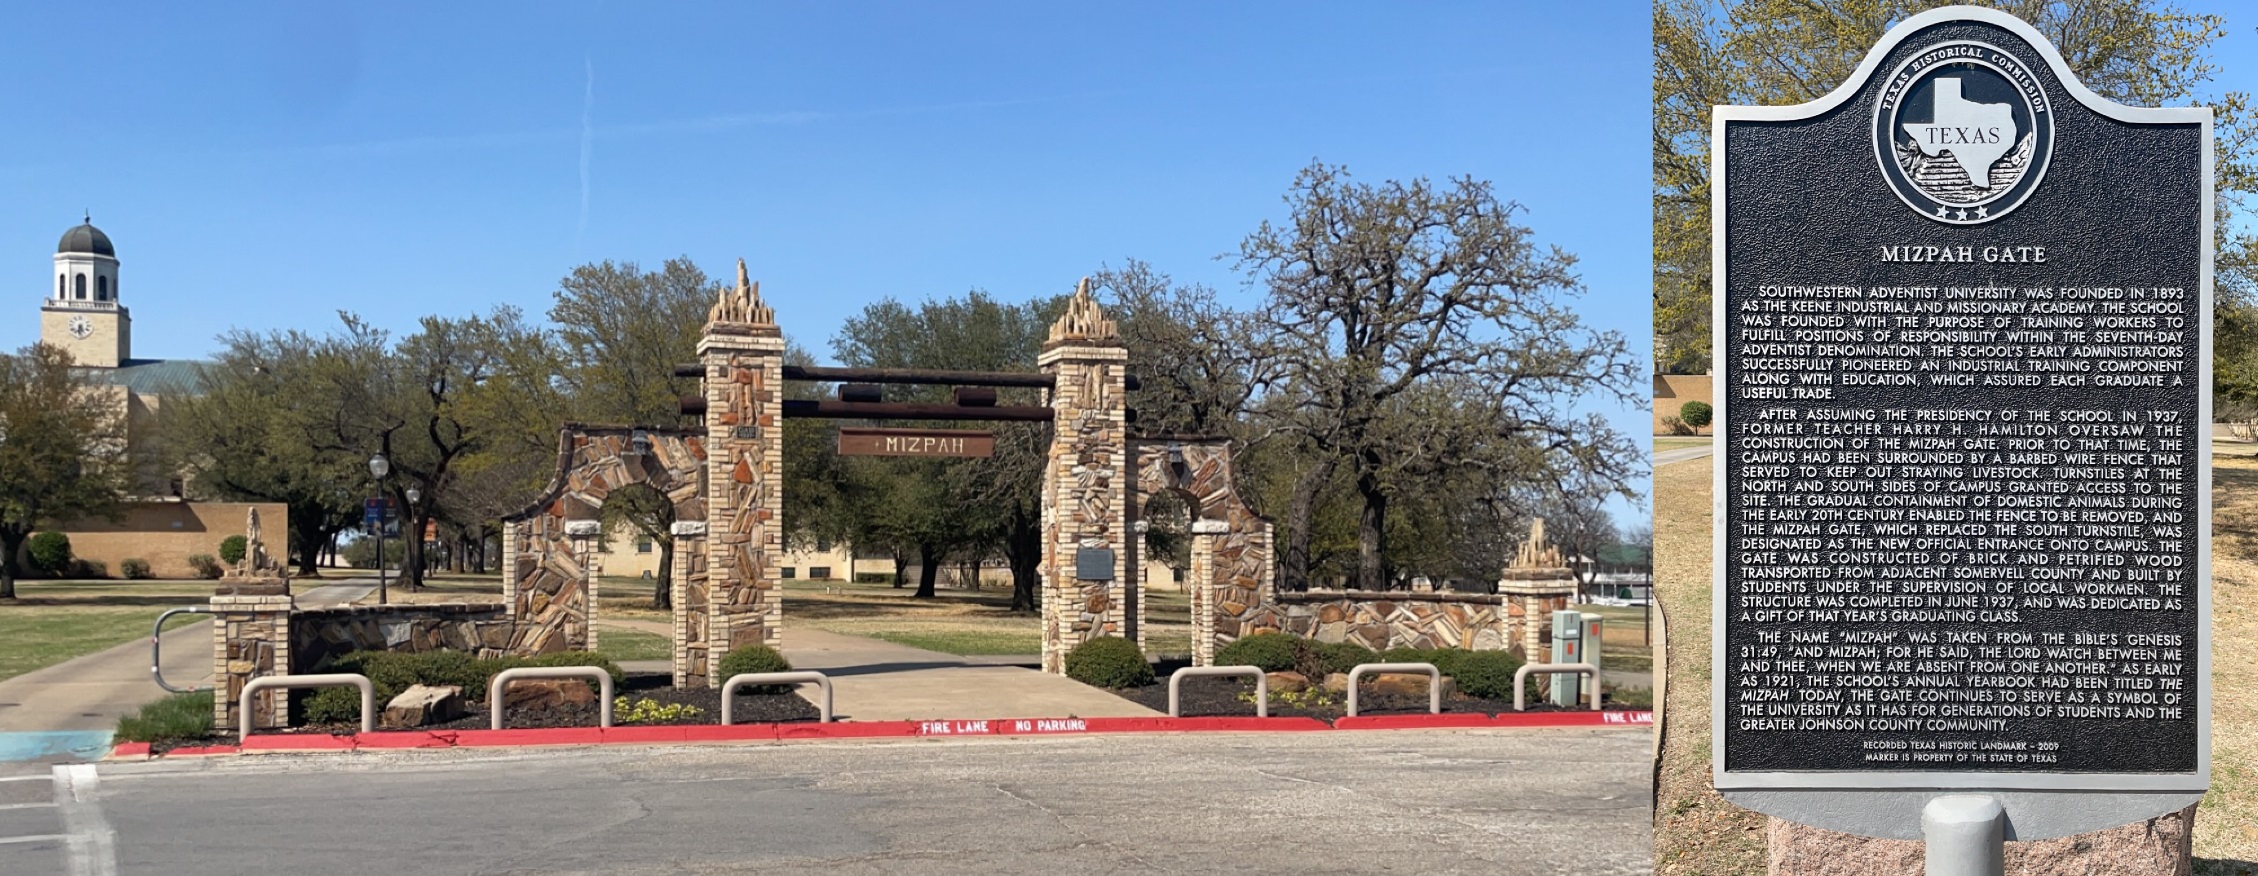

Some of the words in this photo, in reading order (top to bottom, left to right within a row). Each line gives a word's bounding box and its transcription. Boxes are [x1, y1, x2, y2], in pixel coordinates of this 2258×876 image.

[1883, 73, 1909, 110] TEXAS
[1911, 47, 1983, 71] HISTORICAL
[1991, 54, 2045, 114] COMMISSION
[1926, 127, 2000, 144] TEXAS
[1881, 246, 1973, 262] MIZPAH
[1983, 246, 2045, 262] GATE
[1759, 285, 1861, 297] SOUTHWESTERN
[1869, 287, 1938, 298] ADVENTIST
[1943, 287, 2016, 299] UNIVERSITY
[2023, 287, 2053, 299] WAS
[2059, 287, 2123, 299] FOUNDED
[2128, 288, 2144, 298] IN
[2150, 287, 2183, 299] 1893
[1741, 315, 1771, 326] WAS
[1781, 315, 1844, 327] FOUNDED
[1853, 316, 1886, 327] WITH
[1896, 316, 1918, 327] THE
[1929, 316, 1984, 328] PURPOSE
[1991, 317, 2011, 328] OF
[2020, 317, 2083, 328] TRAINING
[2093, 317, 2156, 328] WORKERS
[2165, 317, 2183, 328] TO
[1742, 329, 1787, 341] FULFILL
[1795, 330, 1863, 342] POSITIONS
[1871, 330, 1891, 342] OF
[1899, 331, 1997, 342] RESPONSIBILITY
[2005, 331, 2053, 342] WITHIN
[2062, 331, 2085, 343] THE
[2095, 331, 2183, 343] SEVENTH-DAY
[1742, 358, 1833, 370] SUCCESSFULLY
[1840, 359, 1911, 371] PIONEERED
[1920, 360, 1939, 371] AN
[1948, 360, 2019, 371] INDUSTRIAL
[2027, 360, 2090, 371] TRAINING
[2099, 360, 2182, 372] COMPONENT
[1742, 387, 1788, 399] USEFUL
[1791, 388, 1835, 399] TRADE.
[1759, 408, 1796, 420] AFTER
[1806, 409, 1875, 420] ASSUMING
[1884, 409, 1907, 420] THE
[1915, 409, 1991, 421] PRESIDENCY
[2001, 410, 2018, 421] OF
[2027, 410, 2050, 421] THE
[2059, 410, 2113, 421] SCHOOL
[2122, 411, 2136, 421] IN
[2147, 410, 2182, 423] 1937,
[1742, 423, 1802, 434] FORMER
[1814, 423, 1881, 434] TEACHER
[1892, 424, 1940, 434] HARRY
[1950, 423, 1967, 435] H.
[1979, 424, 2057, 435] HAMILTON
[2067, 425, 2144, 436] OVERSAW
[2155, 425, 2182, 436] THE
[886, 436, 963, 453] MIZPAH
[1742, 437, 1843, 449] CONSTRUCTION
[1852, 438, 1869, 449] OF
[1877, 438, 1900, 449] THE
[1909, 438, 1955, 449] MIZPAH
[1963, 438, 1999, 450] GATE.
[2008, 439, 2044, 450] PRIOR
[2052, 439, 2070, 450] TO
[2078, 439, 2109, 450] THAT
[2117, 439, 2150, 452] TIME,
[2159, 439, 2181, 451] THE
[1742, 466, 1789, 477] SERVED
[1799, 466, 1817, 477] TO
[1826, 466, 1856, 477] KEEP
[1865, 466, 1892, 477] OUT
[1901, 466, 1963, 477] STRAYING
[1973, 467, 2043, 478] LIVESTOCK.
[2053, 467, 2124, 479] TURNSTILES
[2134, 468, 2149, 479] AT
[2159, 468, 2181, 479] THE
[1742, 509, 1764, 520] THE
[1769, 509, 1806, 520] EARLY
[1812, 509, 1842, 520] 20TH
[1847, 509, 1904, 521] CENTURY
[1909, 509, 1964, 521] ENABLED
[1969, 510, 1991, 521] THE
[1996, 510, 2036, 521] FENCE
[2040, 510, 2058, 521] TO
[2062, 511, 2076, 521] BE
[2082, 511, 2148, 524] REMOVED,
[2152, 512, 2182, 523] AND
[1742, 538, 1821, 549] DESIGNATED
[1827, 538, 1844, 549] AS
[1850, 538, 1873, 549] THE
[1879, 538, 1910, 549] NEW
[1916, 538, 1971, 549] OFFICIAL
[1977, 538, 2043, 550] ENTRANCE
[2050, 539, 2089, 550] ONTO
[2094, 540, 2152, 551] CAMPUS.
[2159, 541, 2181, 552] THE
[1742, 566, 1830, 578] TRANSPORTED
[1838, 567, 1874, 578] FROM
[1881, 567, 1946, 578] ADJACENT
[1953, 567, 2024, 578] SOMERVELL
[2031, 568, 2084, 579] COUNTY
[2091, 569, 2120, 580] AND
[2127, 569, 2159, 580] BUILT
[2167, 570, 2182, 581] BY
[1742, 596, 1811, 607] STRUCTURE
[1815, 596, 1844, 607] WAS
[1849, 596, 1922, 607] COMPLETED
[1928, 596, 1941, 607] IN
[1946, 596, 1978, 607] JUNE
[1984, 596, 2018, 609] 1937,
[2023, 597, 2052, 608] AND
[2057, 597, 2085, 608] WAS
[2091, 598, 2160, 610] DEDICATED
[2164, 599, 2181, 610] AS
[1741, 689, 1788, 701] MIZPAH
[1798, 689, 1844, 702] TODAY,
[1850, 689, 1873, 701] THE
[1880, 689, 1912, 701] GATE
[1919, 690, 1992, 701] CONTINUES
[1999, 690, 2016, 702] TO
[2023, 691, 2060, 702] SERVE
[2067, 692, 2084, 703] AS
[2091, 693, 2100, 703] A
[2107, 692, 2157, 704] SYMBOL
[2164, 693, 2181, 704] OF
[1603, 712, 1626, 723] FIRE
[922, 722, 950, 734] FIRE
[957, 721, 988, 733] LANE
[1015, 720, 1032, 731] NO
[1038, 719, 1086, 731] PARKING
[1740, 719, 1795, 730] GREATER
[1799, 719, 1864, 730] JOHNSON
[1869, 719, 1922, 730] COUNTY
[1926, 719, 2008, 731] COMMUNITY.
[1864, 741, 1907, 749] RECORDED
[1911, 741, 1935, 749] TEXAS
[1939, 741, 1976, 750] HISTORIC
[1980, 742, 2026, 750] LANDMARK
[2038, 742, 2058, 751] 2009
[1866, 753, 1898, 761] MARKER
[1902, 753, 1909, 761] IS
[1990, 754, 2012, 762] STATE
[2016, 754, 2027, 762] OF
